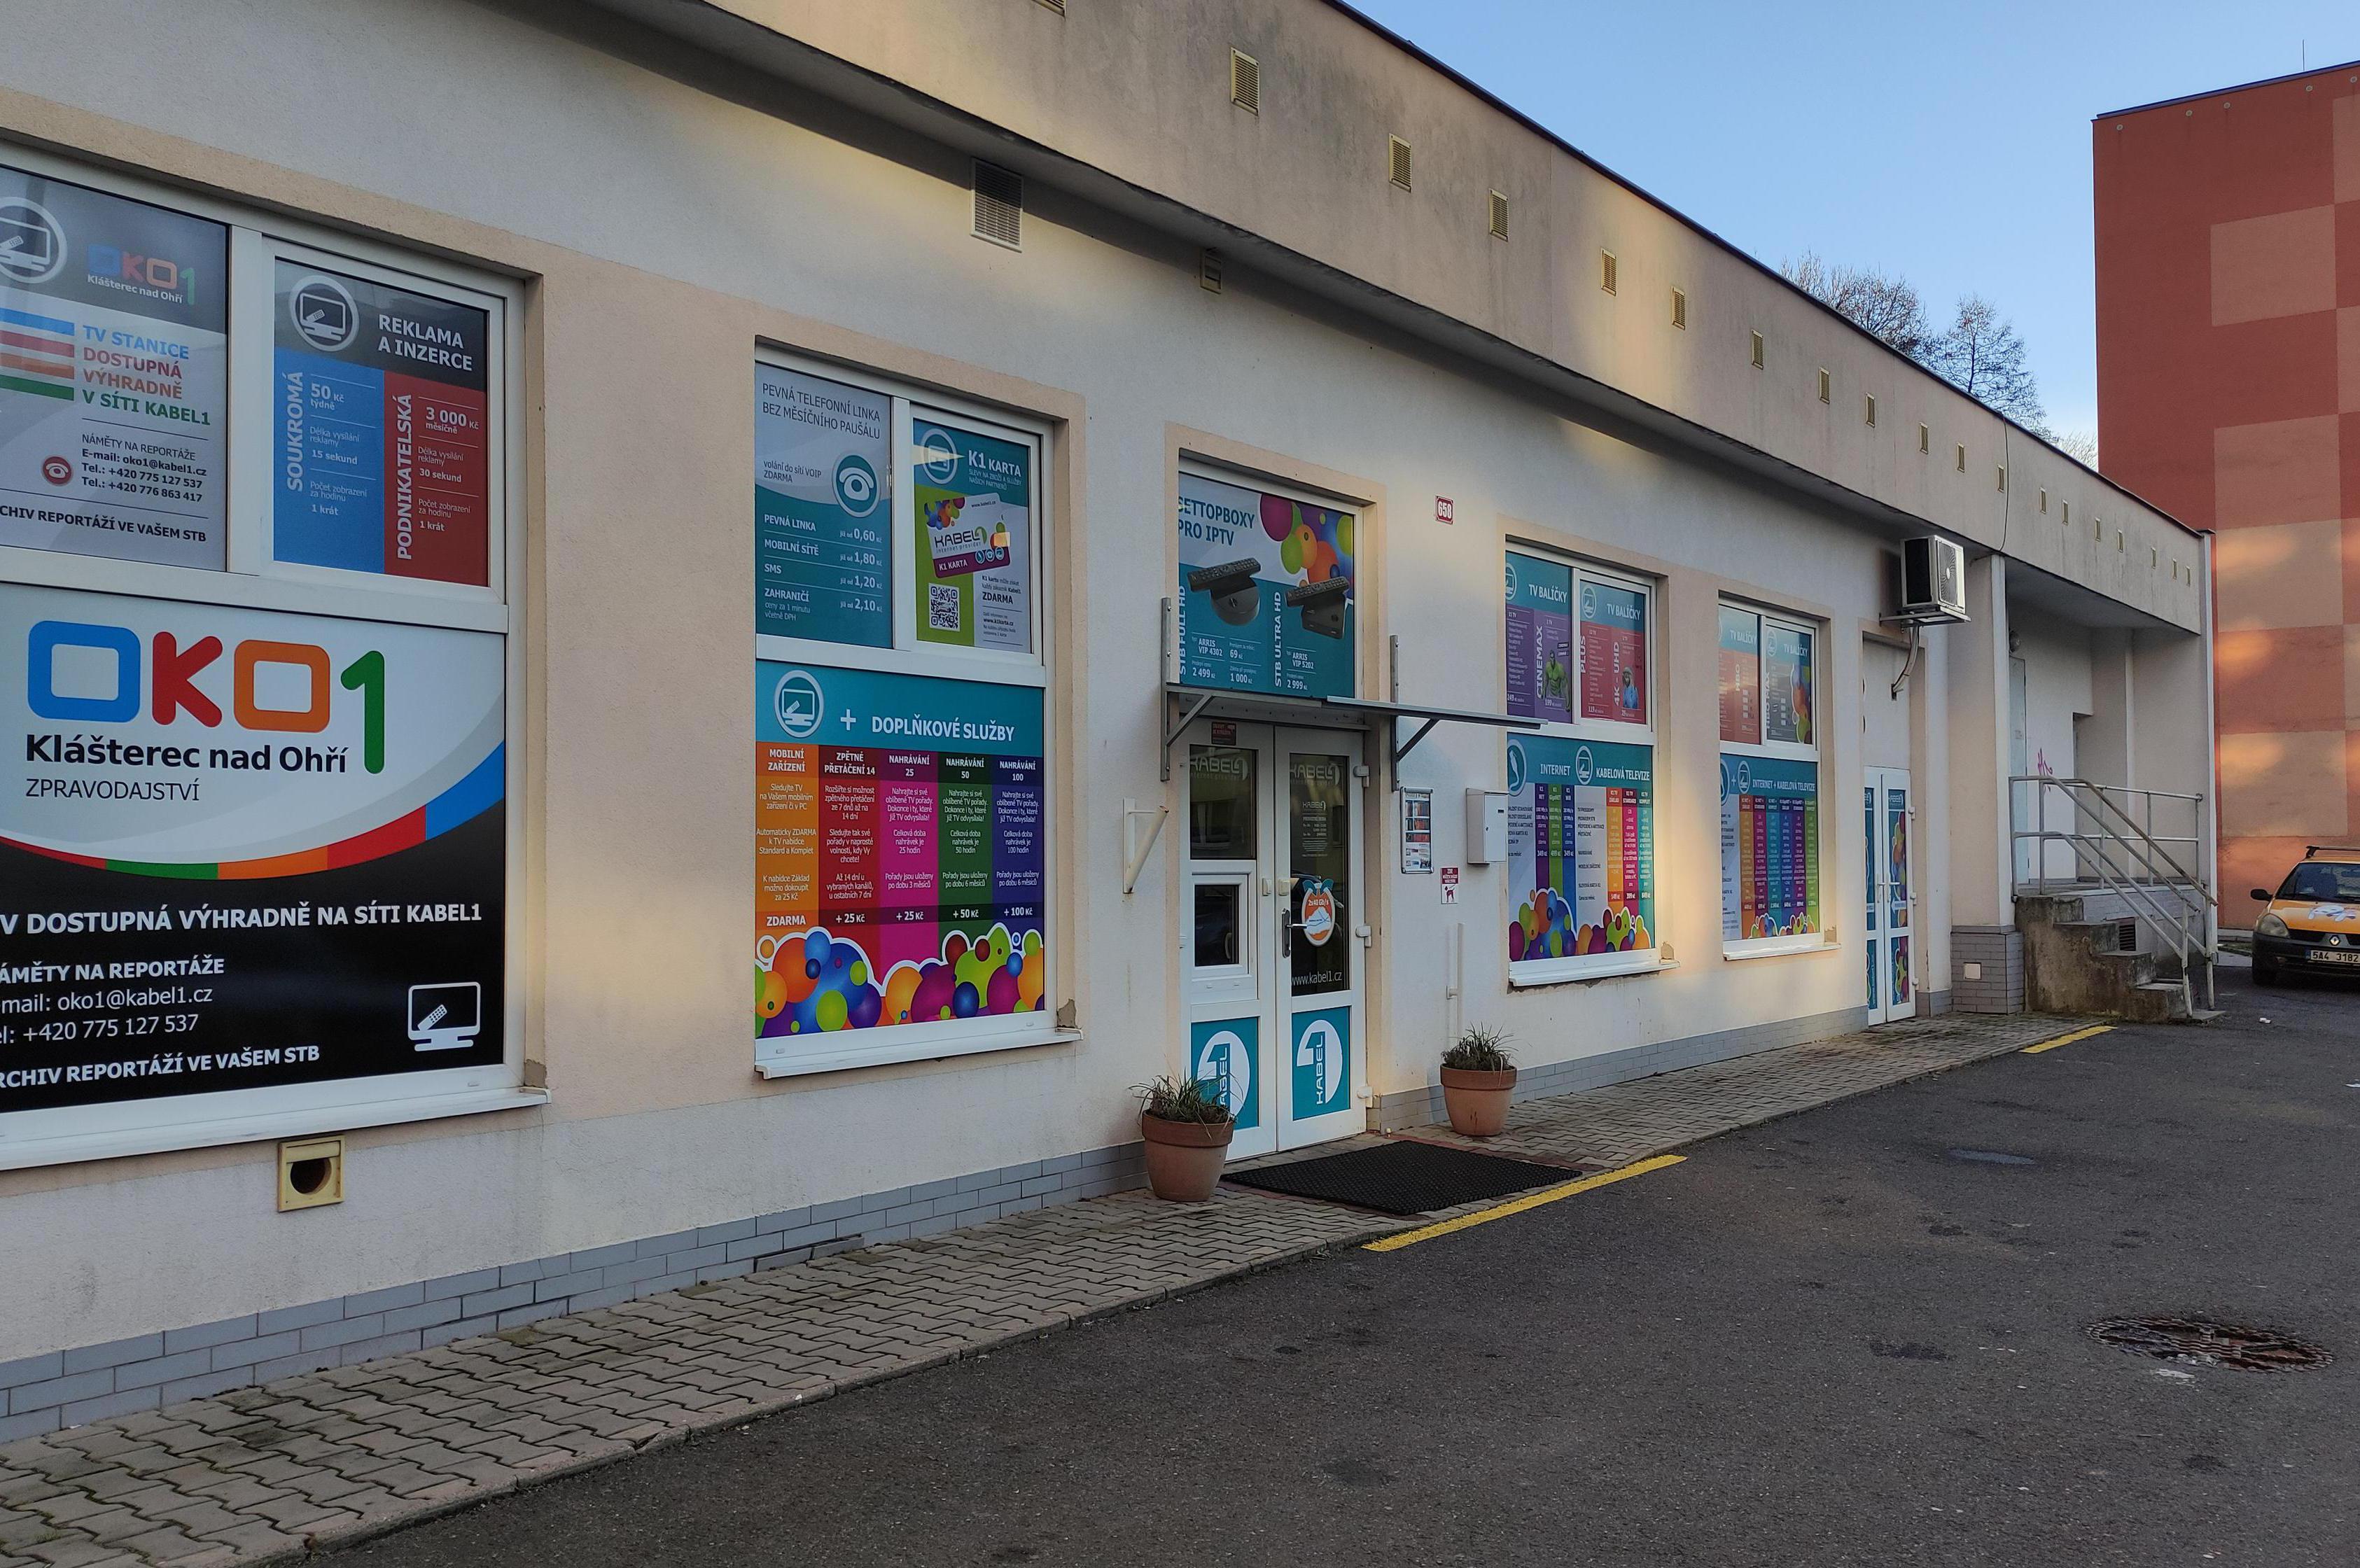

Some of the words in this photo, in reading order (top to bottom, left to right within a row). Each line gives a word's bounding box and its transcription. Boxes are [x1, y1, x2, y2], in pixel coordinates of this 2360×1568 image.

[88, 246, 195, 305] OKO1
[88, 274, 137, 293] Klášterec
[139, 288, 158, 298] nad
[160, 291, 183, 303] Ohří
[379, 314, 463, 349] REKLAMA
[83, 325, 106, 342] TV
[112, 332, 189, 359] STANICE
[83, 347, 182, 379] DOSTUPNÁ
[378, 337, 391, 353] A
[395, 340, 473, 371] INZERCE
[83, 368, 182, 399] VÝHRADNĚ
[311, 384, 330, 400] 50
[334, 393, 344, 403] Kč
[762, 383, 795, 402] PEVNÁ
[797, 391, 850, 415] TELEFONNÍ
[853, 405, 880, 421] LINKA
[83, 390, 95, 404] V
[100, 391, 139, 412] SÍTI
[146, 400, 210, 426] KABEL1
[311, 399, 335, 410] týdně
[426, 407, 435, 420] 3
[439, 410, 466, 426] 000
[469, 420, 479, 430] Kč
[763, 402, 781, 416] BEZ
[783, 405, 838, 429] MĚSÍČNÍHO
[840, 420, 880, 439] PAUŠÁLU
[282, 372, 303, 491] SOUKROMÁ
[426, 421, 458, 435] měsíčně
[82, 433, 122, 449] NÁMĚTY
[125, 442, 138, 451] NA
[141, 444, 195, 461] REPORTÁŽE
[82, 449, 120, 462] E-mail:
[123, 456, 207, 476] oko1@kabel1.cz
[763, 460, 783, 470] volání
[794, 465, 804, 475] sítí
[805, 468, 822, 478] VOIP
[968, 449, 986, 468] K1
[989, 458, 1021, 477] KARTA
[82, 463, 105, 474] Tel.:
[109, 468, 137, 479] +420
[139, 471, 159, 482] 775
[162, 475, 181, 485] 127
[183, 478, 202, 489] 537
[392, 394, 412, 560] PODNIKATELSKÁ
[419, 468, 430, 477] 30
[432, 470, 462, 483] sekund
[764, 470, 793, 483] ZDARMA
[82, 477, 105, 488] Tel.:
[109, 482, 137, 493] +420
[139, 485, 159, 496] 776
[162, 489, 181, 499] 863
[183, 491, 202, 503] 417
[1178, 496, 1255, 528] SETTOPBOXY
[1438, 501, 1452, 519] 658
[38, 510, 115, 530] REPORTÁŽÍ
[118, 521, 134, 532] VE
[137, 523, 180, 538] VAŠEM
[183, 530, 206, 542] STB
[764, 514, 790, 527] PEVNÁ
[792, 518, 816, 531] LINKA
[853, 528, 875, 542] 0,60
[1178, 519, 1202, 539] PRO
[1206, 525, 1234, 545] IPTV
[764, 539, 800, 552] MOBILNÍ
[801, 542, 819, 556] SÍTĚ
[854, 552, 875, 566] 1,80
[939, 563, 947, 571] K1
[949, 559, 968, 569] KARTA
[764, 564, 782, 574] SMS
[855, 575, 875, 589] 1,20
[764, 588, 809, 602] ZAHRANIČÍ
[982, 592, 1013, 605] ZDARMA
[1275, 592, 1281, 612] HD
[1529, 584, 1537, 595] TV
[1539, 586, 1567, 603] BALÍČKY
[855, 598, 875, 612] 2,10
[1607, 604, 1614, 615] TV
[1616, 605, 1640, 620] BALÍČKY
[1199, 638, 1215, 647] ARRIS
[1730, 630, 1736, 640] TV
[1737, 630, 1757, 644] BALÍČKY
[1199, 646, 1208, 654] VIP
[1209, 647, 1222, 657] 4302
[1784, 644, 1789, 652] TV
[1790, 645, 1808, 656] BALÍČKY
[28, 620, 385, 774] OKO1
[1614, 686, 1620, 706] 4K
[872, 713, 960, 738] DOPLŇKOVÉ
[963, 720, 1014, 741] SLUŽBY
[26, 734, 200, 769] Klášterec
[209, 745, 270, 771] nad
[279, 745, 347, 774] Ohří
[769, 748, 804, 760] MOBILNÍ
[837, 750, 864, 762] ZPĚTNÉ
[889, 754, 930, 765] NAHRÁVÁNÍ
[946, 756, 984, 768] NAHRÁVÁNÍ
[768, 760, 805, 772] ZAŘÍZENÍ
[825, 762, 865, 774] PŘETÁČENÍ
[867, 766, 875, 775] 14
[905, 769, 914, 777] 25
[1000, 760, 1035, 770] NAHRÁVÁNÍ
[1540, 764, 1570, 776] INTERNET
[1596, 766, 1625, 780] KABELOVÁ
[1626, 769, 1650, 780] TELEVIZE
[1012, 774, 1024, 782] 100
[1753, 779, 1773, 789] INTERNET
[1777, 780, 1797, 790] KABELOVÁ
[1798, 782, 1815, 792] TELEVIZE
[26, 778, 200, 802] ZPRAVODAJSTVÍ
[27, 904, 171, 934] DOSTUPNÁ
[179, 902, 311, 930] VÝHRADNĚ
[317, 906, 349, 925] NA
[354, 900, 400, 925] SÍTI
[407, 904, 482, 923] KABEL1
[767, 916, 806, 927] ZDARMA
[844, 913, 855, 923] 25
[856, 913, 865, 923] Kč
[2313, 951, 2329, 960] 5A4
[2336, 953, 2359, 962] 3182
[75, 963, 104, 981] NA
[109, 955, 225, 979] REPORTÁŽE
[1292, 970, 1343, 986] www.kabel1.cz
[57, 985, 213, 1012] oko1@kabel1.cz
[0, 1026, 14, 1044] l:
[23, 1022, 76, 1042] +420
[83, 1019, 118, 1037] 775
[125, 1016, 159, 1036] 127
[165, 1014, 198, 1033] 537
[67, 1057, 183, 1083] REPORTÁŽÍ
[187, 1055, 211, 1072] VE
[216, 1047, 280, 1069] VAŠEM
[284, 1045, 319, 1063] STB
